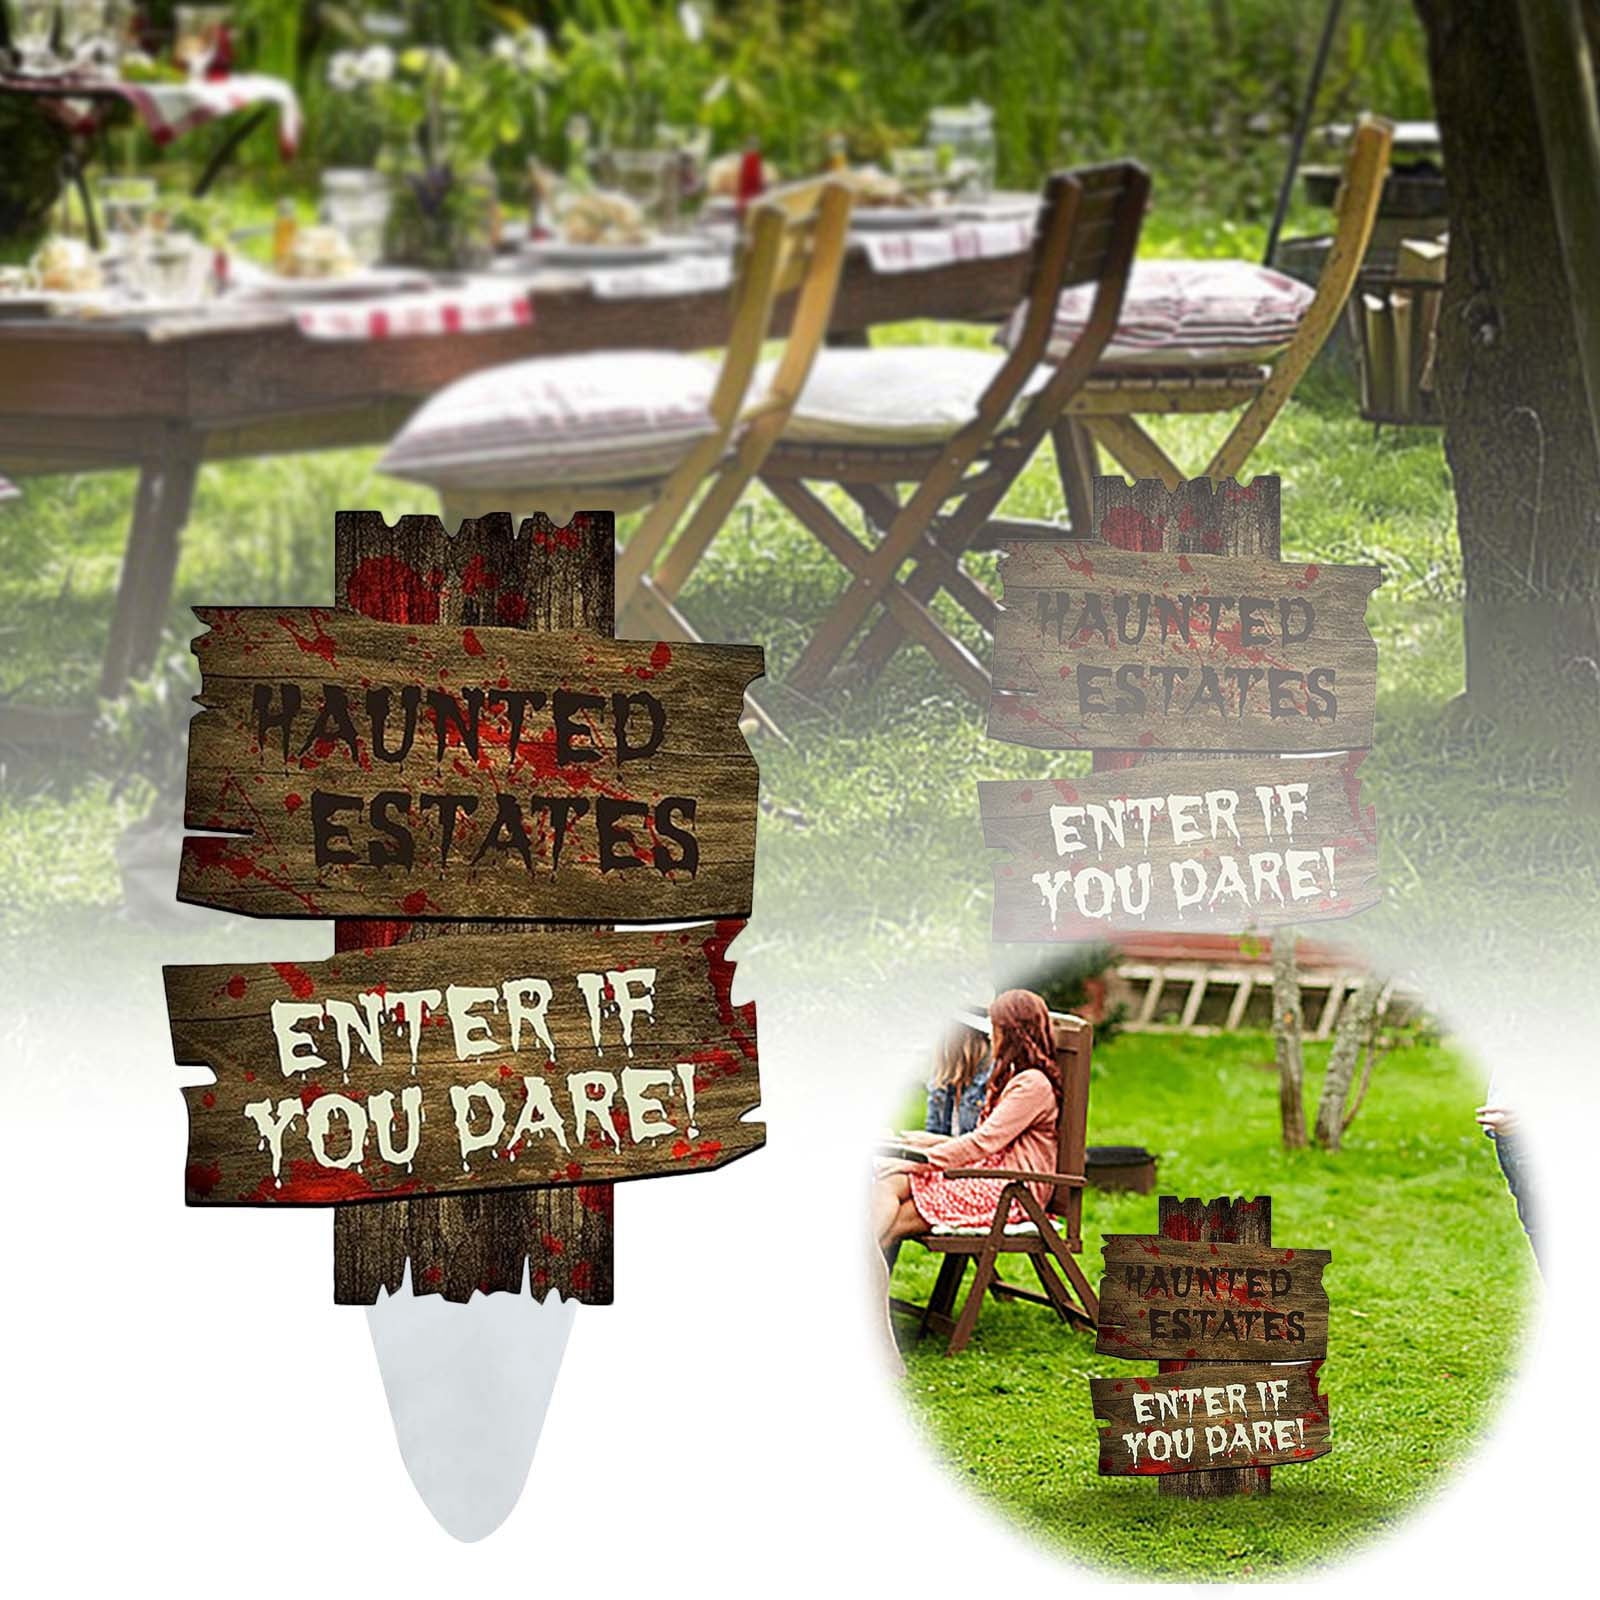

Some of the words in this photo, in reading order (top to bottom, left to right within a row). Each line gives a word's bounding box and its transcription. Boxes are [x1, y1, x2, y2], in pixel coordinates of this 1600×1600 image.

[1037, 592, 1316, 650] HAUNTED
[1076, 664, 1338, 723] ESTATES
[253, 684, 667, 773] HAUNTED
[310, 790, 700, 880] ESTATES
[1049, 790, 1242, 861] ENTER
[1256, 783, 1309, 843] IF
[1032, 861, 1153, 931] YOU
[1169, 847, 1338, 919] DARE!
[271, 978, 556, 1083] ENTER
[577, 968, 658, 1058] IF
[245, 1085, 426, 1188] YOU
[450, 1064, 700, 1172] DARE!
[1125, 1265, 1292, 1299] HAUNTED
[1150, 1309, 1306, 1342] ESTATES
[1132, 1384, 1248, 1426] ENTER
[1256, 1380, 1288, 1416] IF
[1122, 1427, 1196, 1468] YOU
[1205, 1418, 1306, 1461] DARE!
